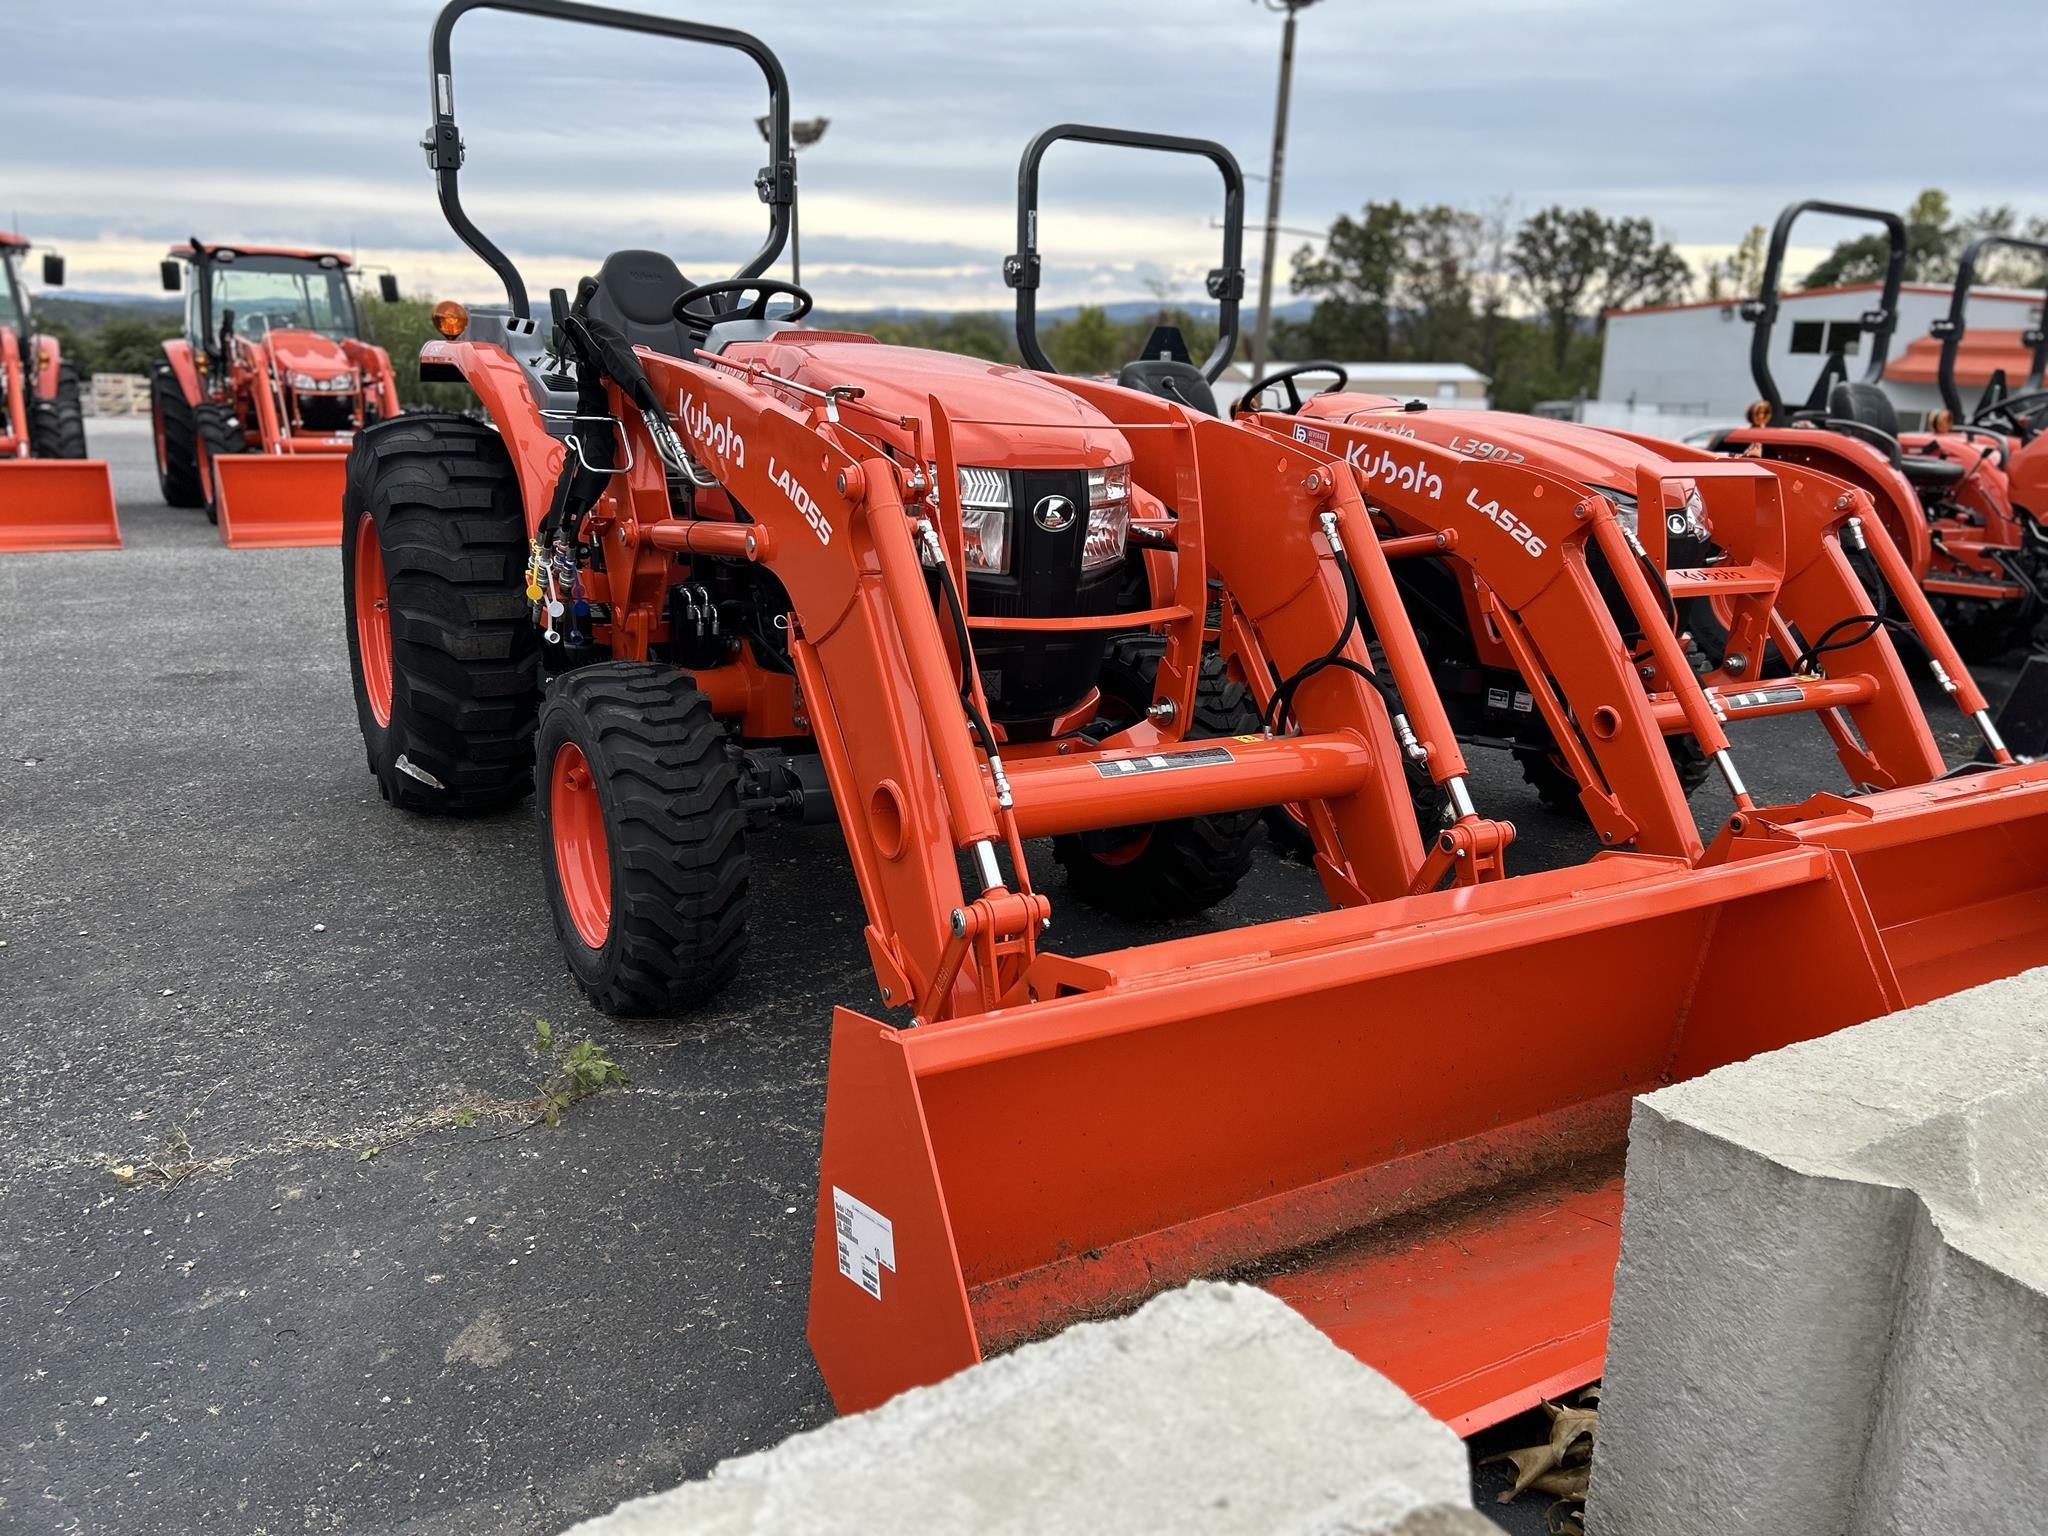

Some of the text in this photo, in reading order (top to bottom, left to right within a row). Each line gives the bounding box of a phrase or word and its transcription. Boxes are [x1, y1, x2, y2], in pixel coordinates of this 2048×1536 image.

[679, 387, 745, 469] Kubota
[767, 456, 834, 546] LA1055
[1345, 439, 1443, 500] Kubota
[1466, 487, 1548, 558] LA526
[1674, 569, 1747, 582] Kubota
